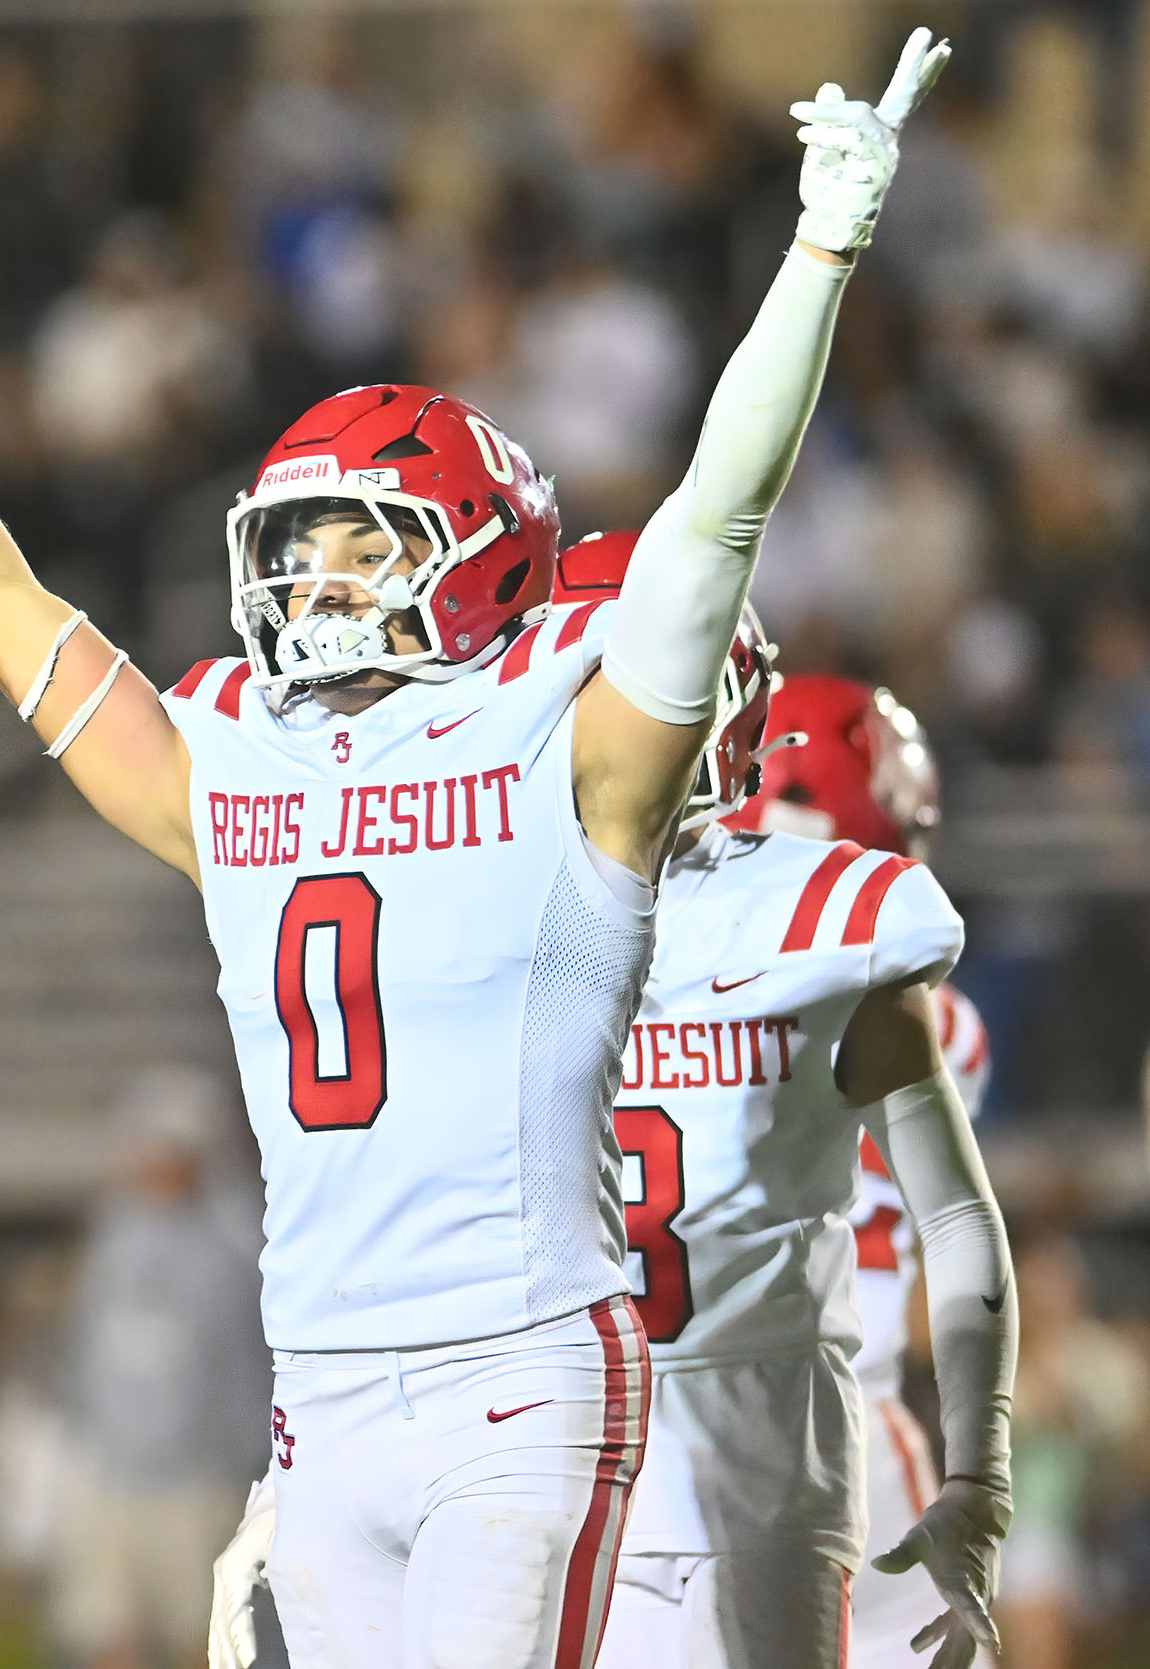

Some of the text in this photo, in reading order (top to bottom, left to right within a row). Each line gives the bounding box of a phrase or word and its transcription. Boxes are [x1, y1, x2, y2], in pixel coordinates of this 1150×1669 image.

[262, 462, 329, 488] Riddell
[464, 414, 515, 486] 0
[208, 762, 522, 867] REGIS JESUIT
[273, 870, 388, 1133] 0
[621, 1016, 800, 1090] JESUIT
